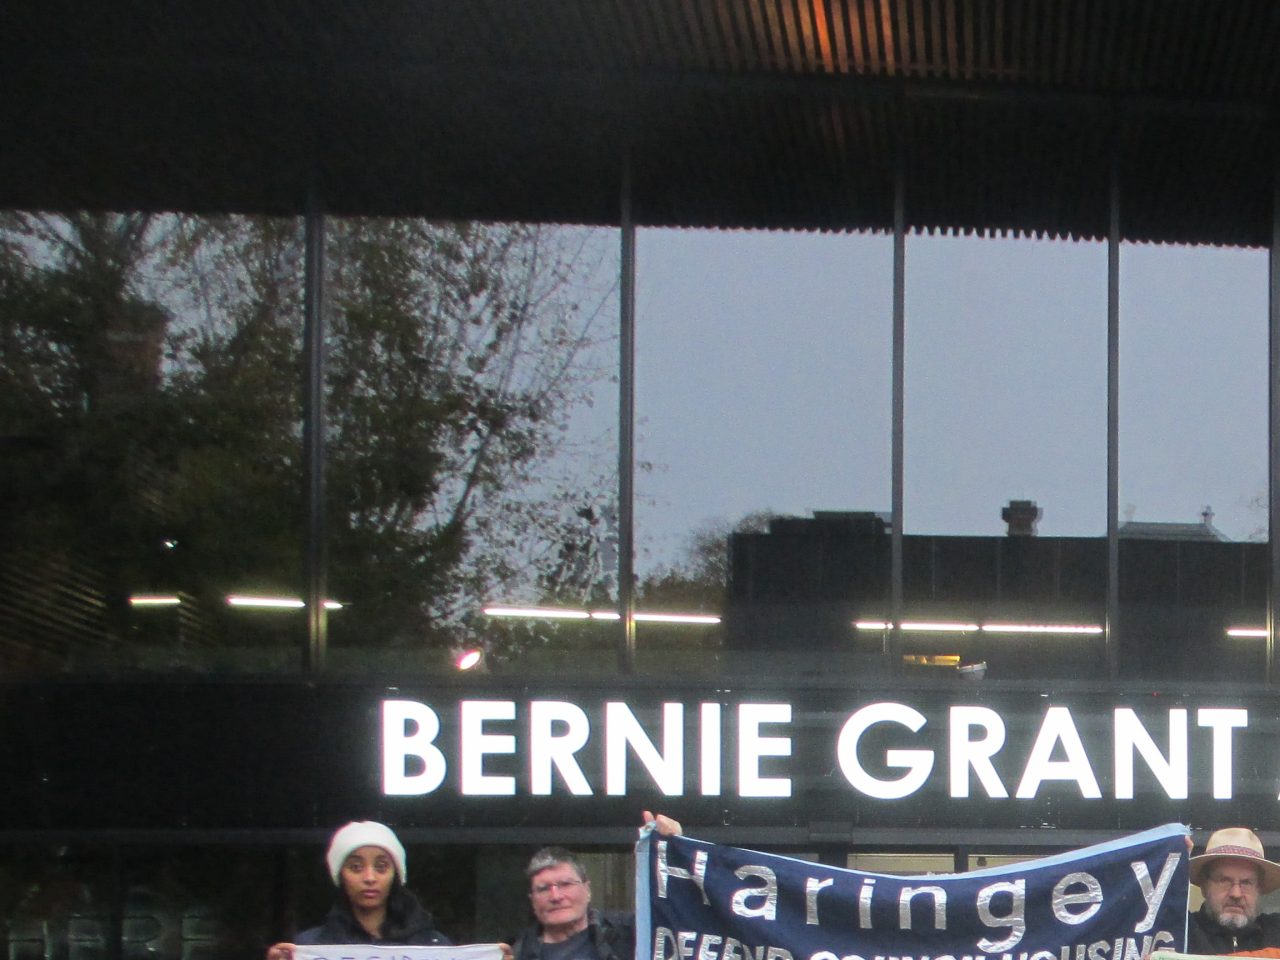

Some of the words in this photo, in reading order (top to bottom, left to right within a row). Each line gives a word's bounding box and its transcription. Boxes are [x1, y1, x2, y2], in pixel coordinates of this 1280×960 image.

[384, 701, 792, 797] BERNIE
[838, 703, 1248, 799] GRANT
[656, 840, 1182, 953] Haringey
